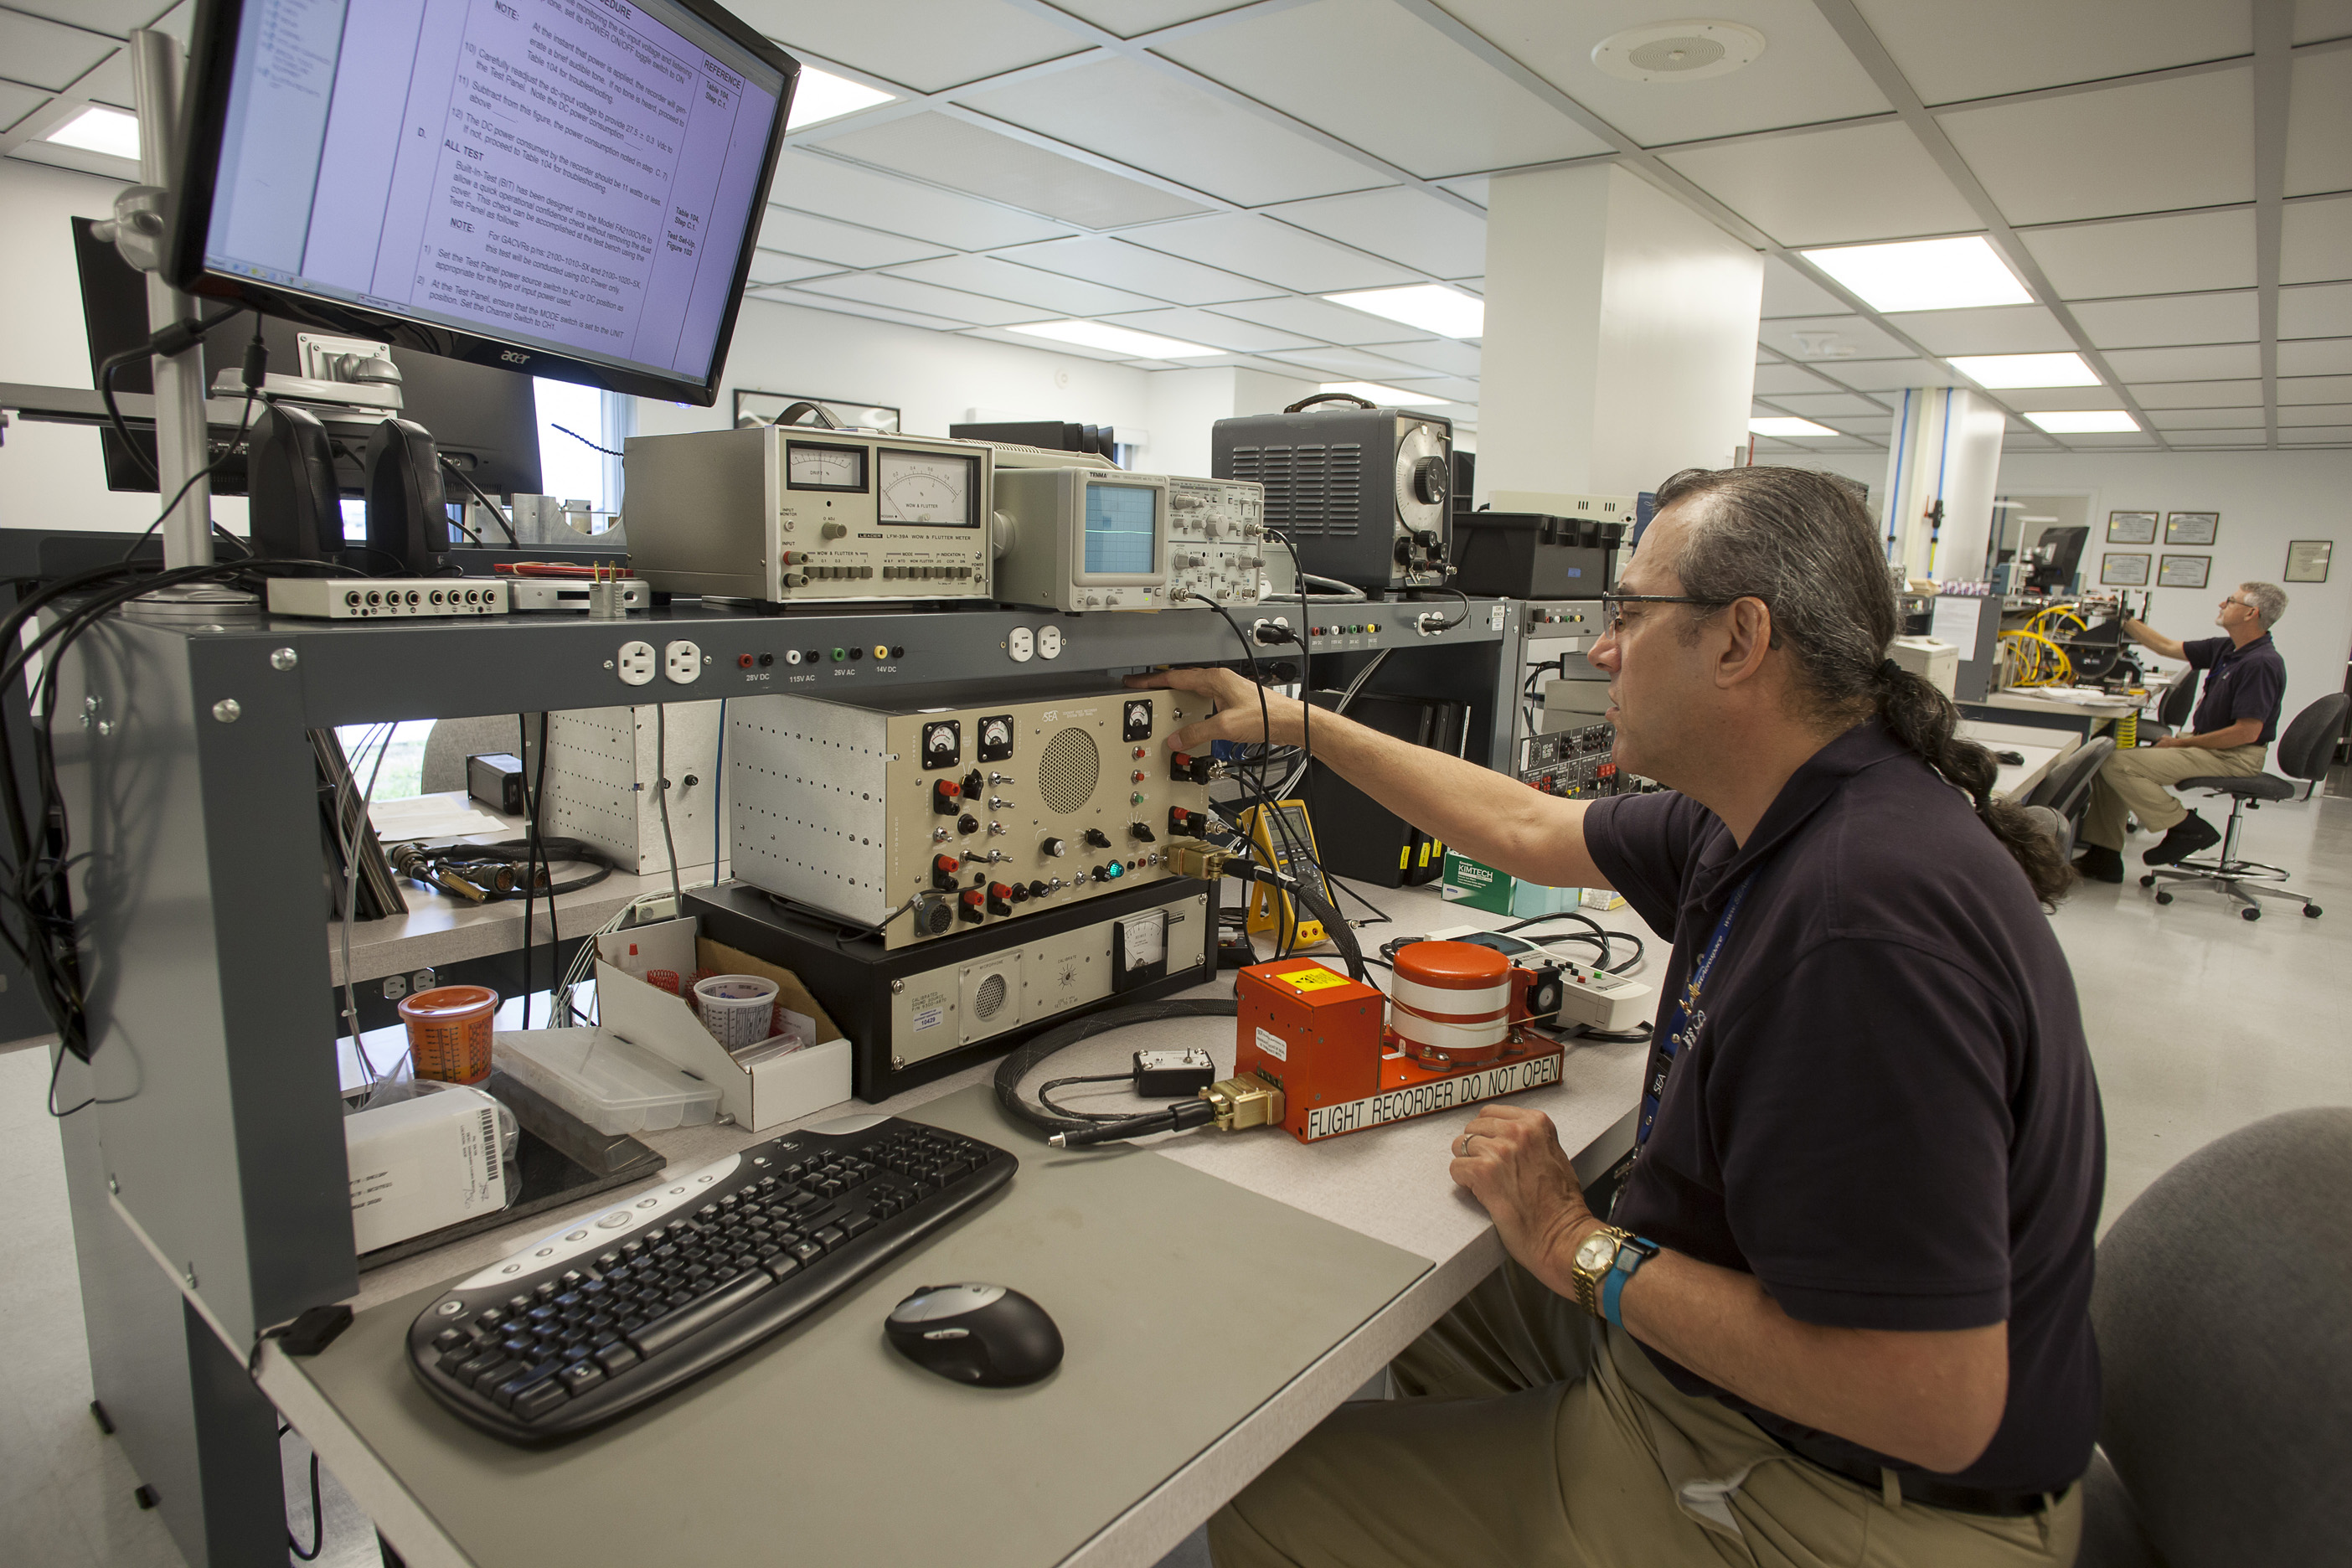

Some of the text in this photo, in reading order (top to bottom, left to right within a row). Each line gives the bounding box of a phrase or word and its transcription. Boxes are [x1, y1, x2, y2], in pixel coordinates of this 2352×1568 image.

[494, 0, 519, 22] NOTE:
[564, 7, 575, 20] set
[575, 13, 584, 25] its
[583, 18, 610, 40] POWER
[610, 34, 634, 54] ON/OFF
[633, 49, 652, 67] toggle
[652, 59, 668, 75] switch
[575, 1, 693, 80] monitoring the dc-input voltage and listening
[540, 27, 552, 40] the
[552, 34, 575, 52] instant
[575, 46, 587, 59] that
[586, 54, 606, 71] power
[611, 67, 635, 87] applied,
[634, 80, 644, 91] the
[644, 85, 667, 103] recorder
[666, 97, 676, 108] will
[675, 104, 687, 116] gen-
[704, 59, 740, 89] REFERENCE
[477, 49, 509, 74] Carefully
[509, 65, 538, 88] readjust
[538, 80, 549, 91] the
[549, 85, 575, 106] dc-input
[575, 98, 597, 117] voltage
[604, 113, 626, 132] provide
[625, 124, 638, 137] 27.5
[645, 133, 655, 144] 0.3
[656, 139, 667, 151] Vdc
[704, 91, 717, 106] Step
[705, 80, 730, 102] Table 104,
[444, 138, 483, 162] ALL TEST
[497, 178, 515, 192] (BIT)
[515, 184, 529, 196] has
[529, 189, 545, 203] been
[544, 196, 574, 215] designed
[575, 208, 586, 219] into
[586, 213, 596, 223] the
[596, 216, 614, 230] Model
[673, 216, 686, 229] Step
[674, 207, 700, 224] Table 104,
[450, 218, 476, 233] NOTE:
[665, 240, 693, 256] Figure 103
[666, 231, 696, 250] Test Set-Up,
[487, 230, 500, 241] For
[500, 235, 529, 251] GACVRs
[590, 266, 601, 275] and
[429, 290, 459, 307] position.
[459, 298, 472, 308] Set
[472, 302, 484, 312] the
[485, 305, 513, 319] Channel
[513, 312, 534, 324] Switch
[541, 320, 557, 331] CH1.
[501, 350, 530, 364] acer
[1042, 710, 1059, 722] SEA
[1458, 864, 1493, 878] KIMTECH
[979, 960, 1003, 970] MICROPHONE
[1058, 955, 1076, 964] CALIBRATE
[911, 992, 938, 1003] CALIBRATED
[928, 994, 944, 1003] SOURCE
[921, 1017, 936, 1026] 10429
[1653, 1073, 1666, 1095] SEA
[1310, 1055, 1559, 1138] FLIGHT RECORDER DO NOT OPEN
